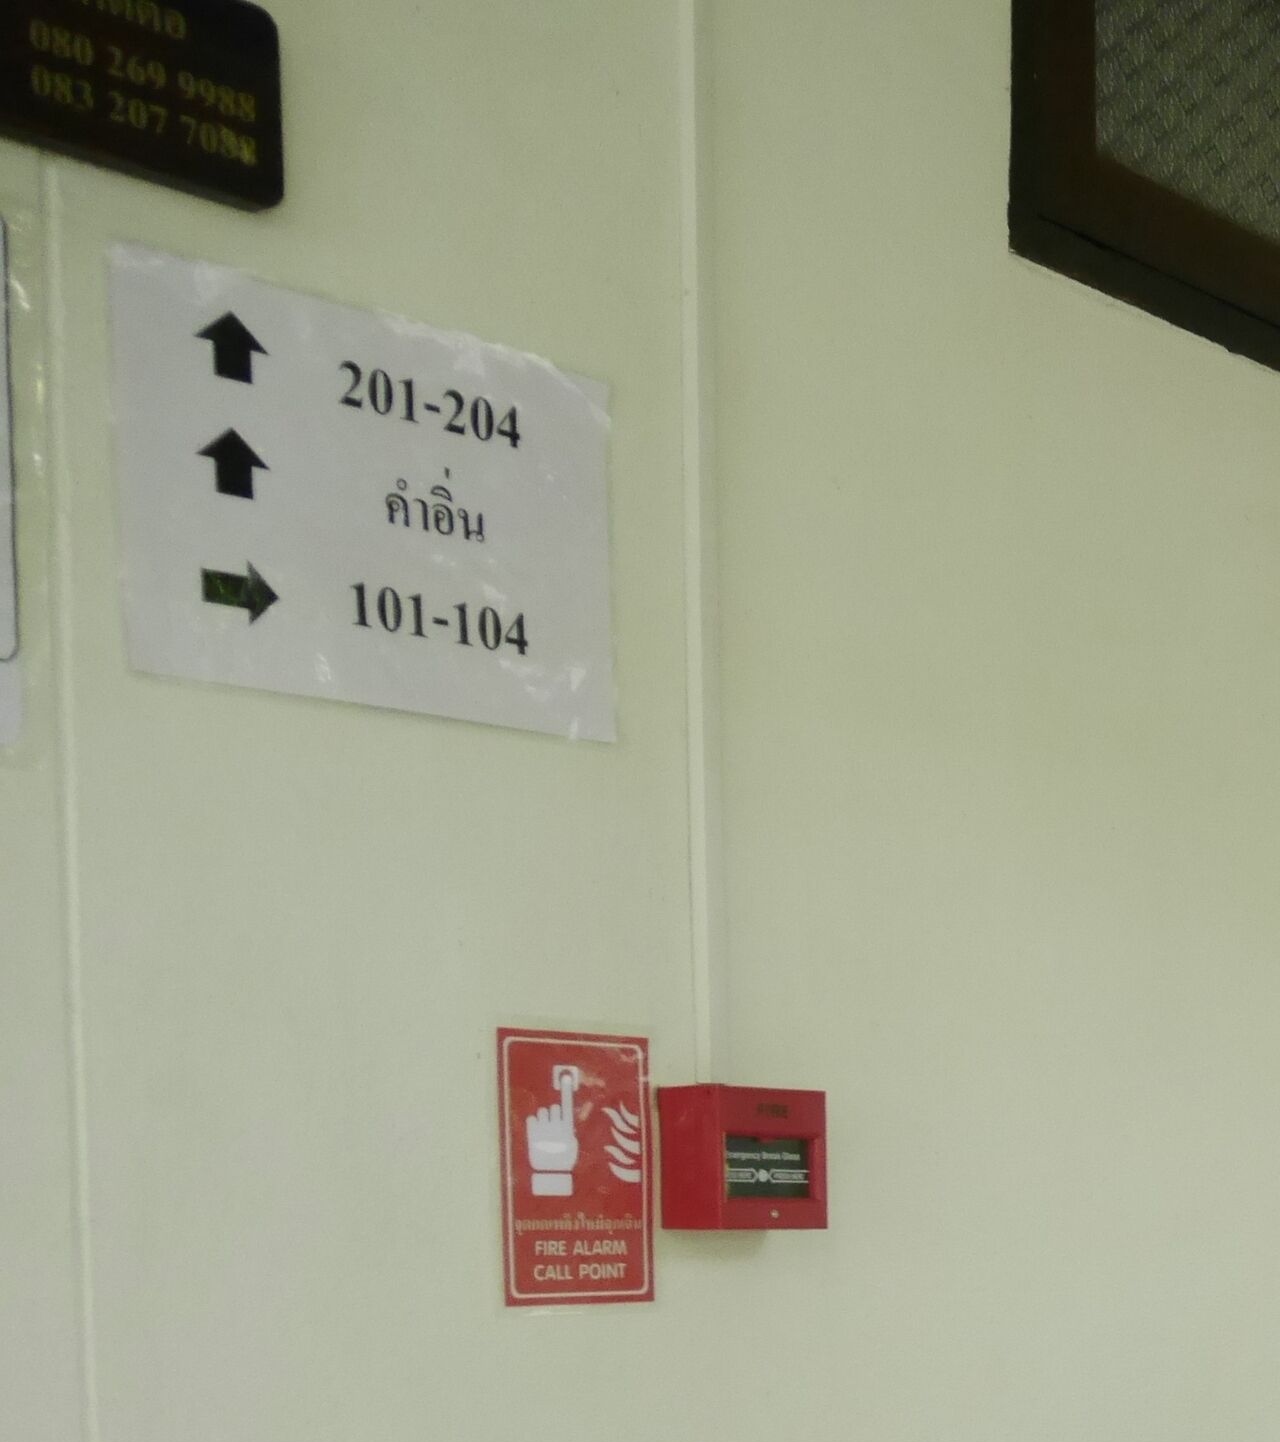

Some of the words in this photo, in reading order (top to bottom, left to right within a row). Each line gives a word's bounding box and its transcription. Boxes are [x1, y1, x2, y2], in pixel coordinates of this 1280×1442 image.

[106, 45, 167, 89] 269
[339, 360, 520, 449] 201-204
[350, 582, 528, 655] 101-104
[535, 1240, 567, 1256] FIRE
[573, 1240, 628, 1256] ALARM
[533, 1264, 573, 1280] CALL
[578, 1263, 627, 1279] POINT
